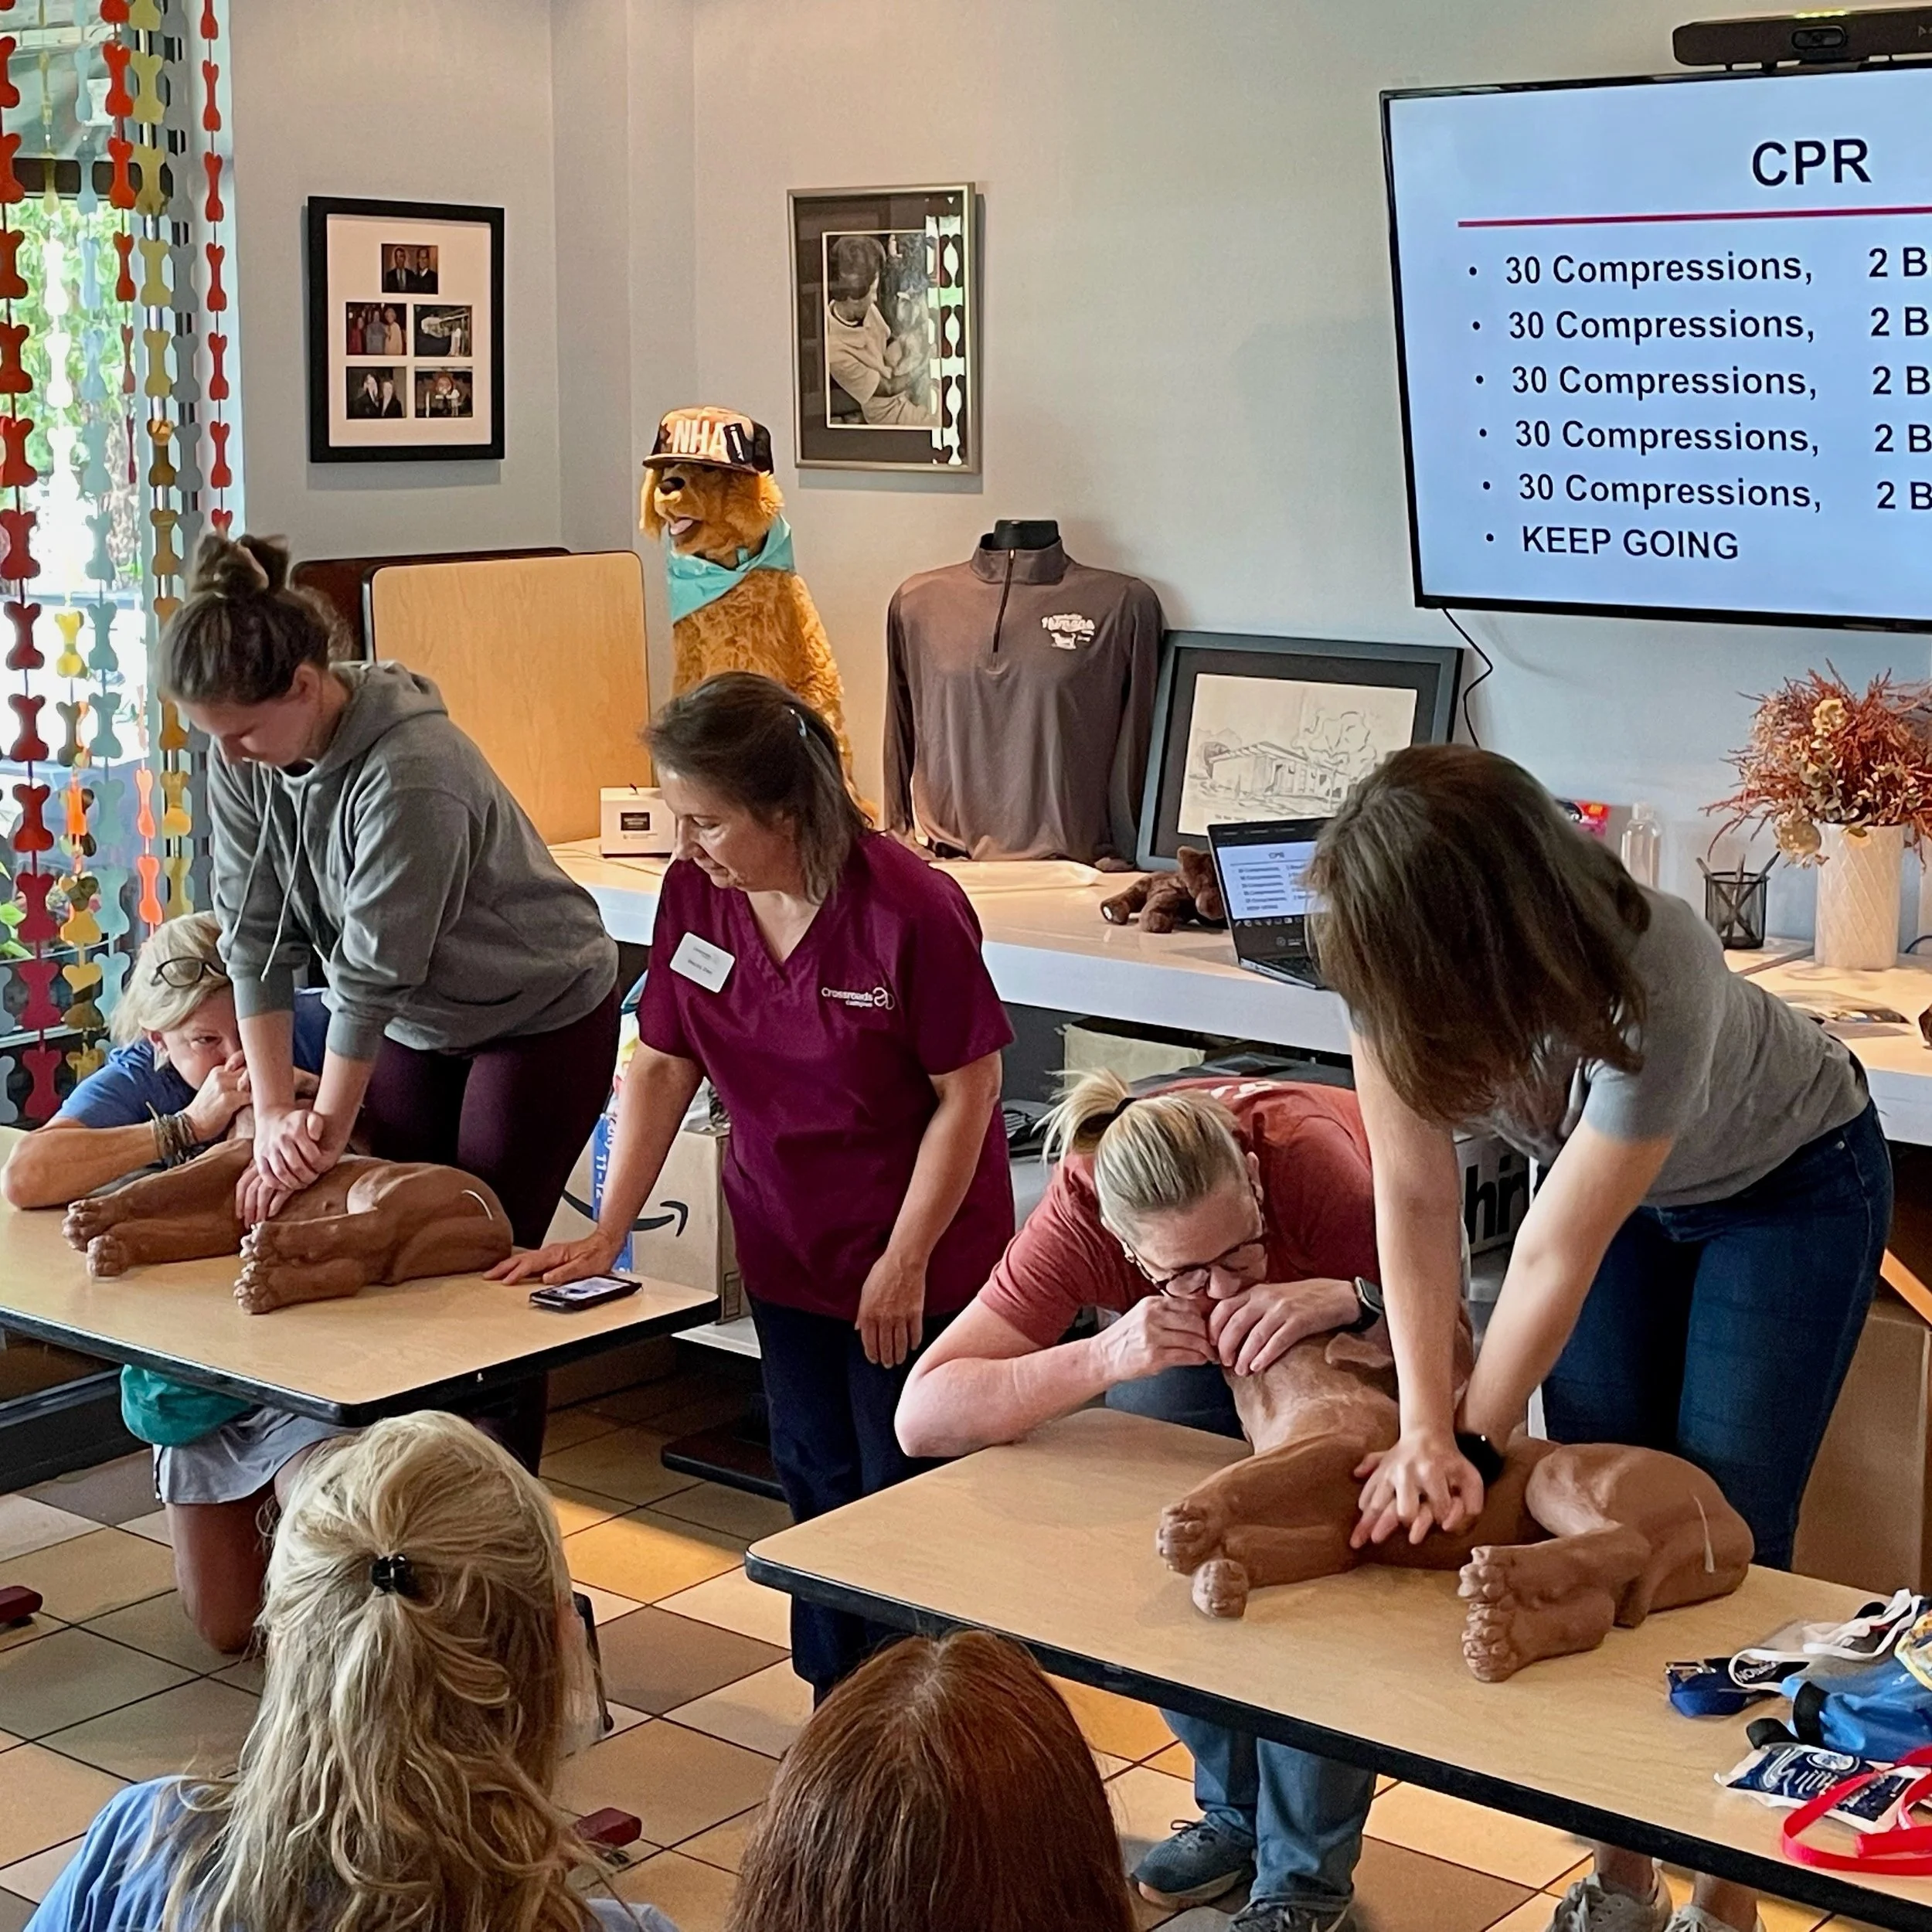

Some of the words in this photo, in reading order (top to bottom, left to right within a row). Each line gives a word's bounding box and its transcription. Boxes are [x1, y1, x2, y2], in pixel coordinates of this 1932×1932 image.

[1752, 138, 1872, 186] CPR
[1505, 256, 1540, 284] 30
[1553, 251, 1812, 290] Compressions,
[1869, 247, 1888, 277] 2
[1509, 311, 1544, 339] 30
[1556, 308, 1815, 345] Compressions,
[1871, 307, 1889, 336] 2
[1512, 366, 1547, 393] 30
[1560, 366, 1816, 401] Compressions,
[1872, 366, 1892, 395] 2
[1515, 420, 1550, 447] 30
[1563, 420, 1818, 457] Compressions,
[1875, 423, 1894, 452] 2
[1519, 473, 1553, 500] 30
[1566, 474, 1821, 513] Compressions,
[1877, 481, 1896, 509] 2
[1522, 526, 1611, 555] KEEP
[1623, 529, 1738, 560] GOING
